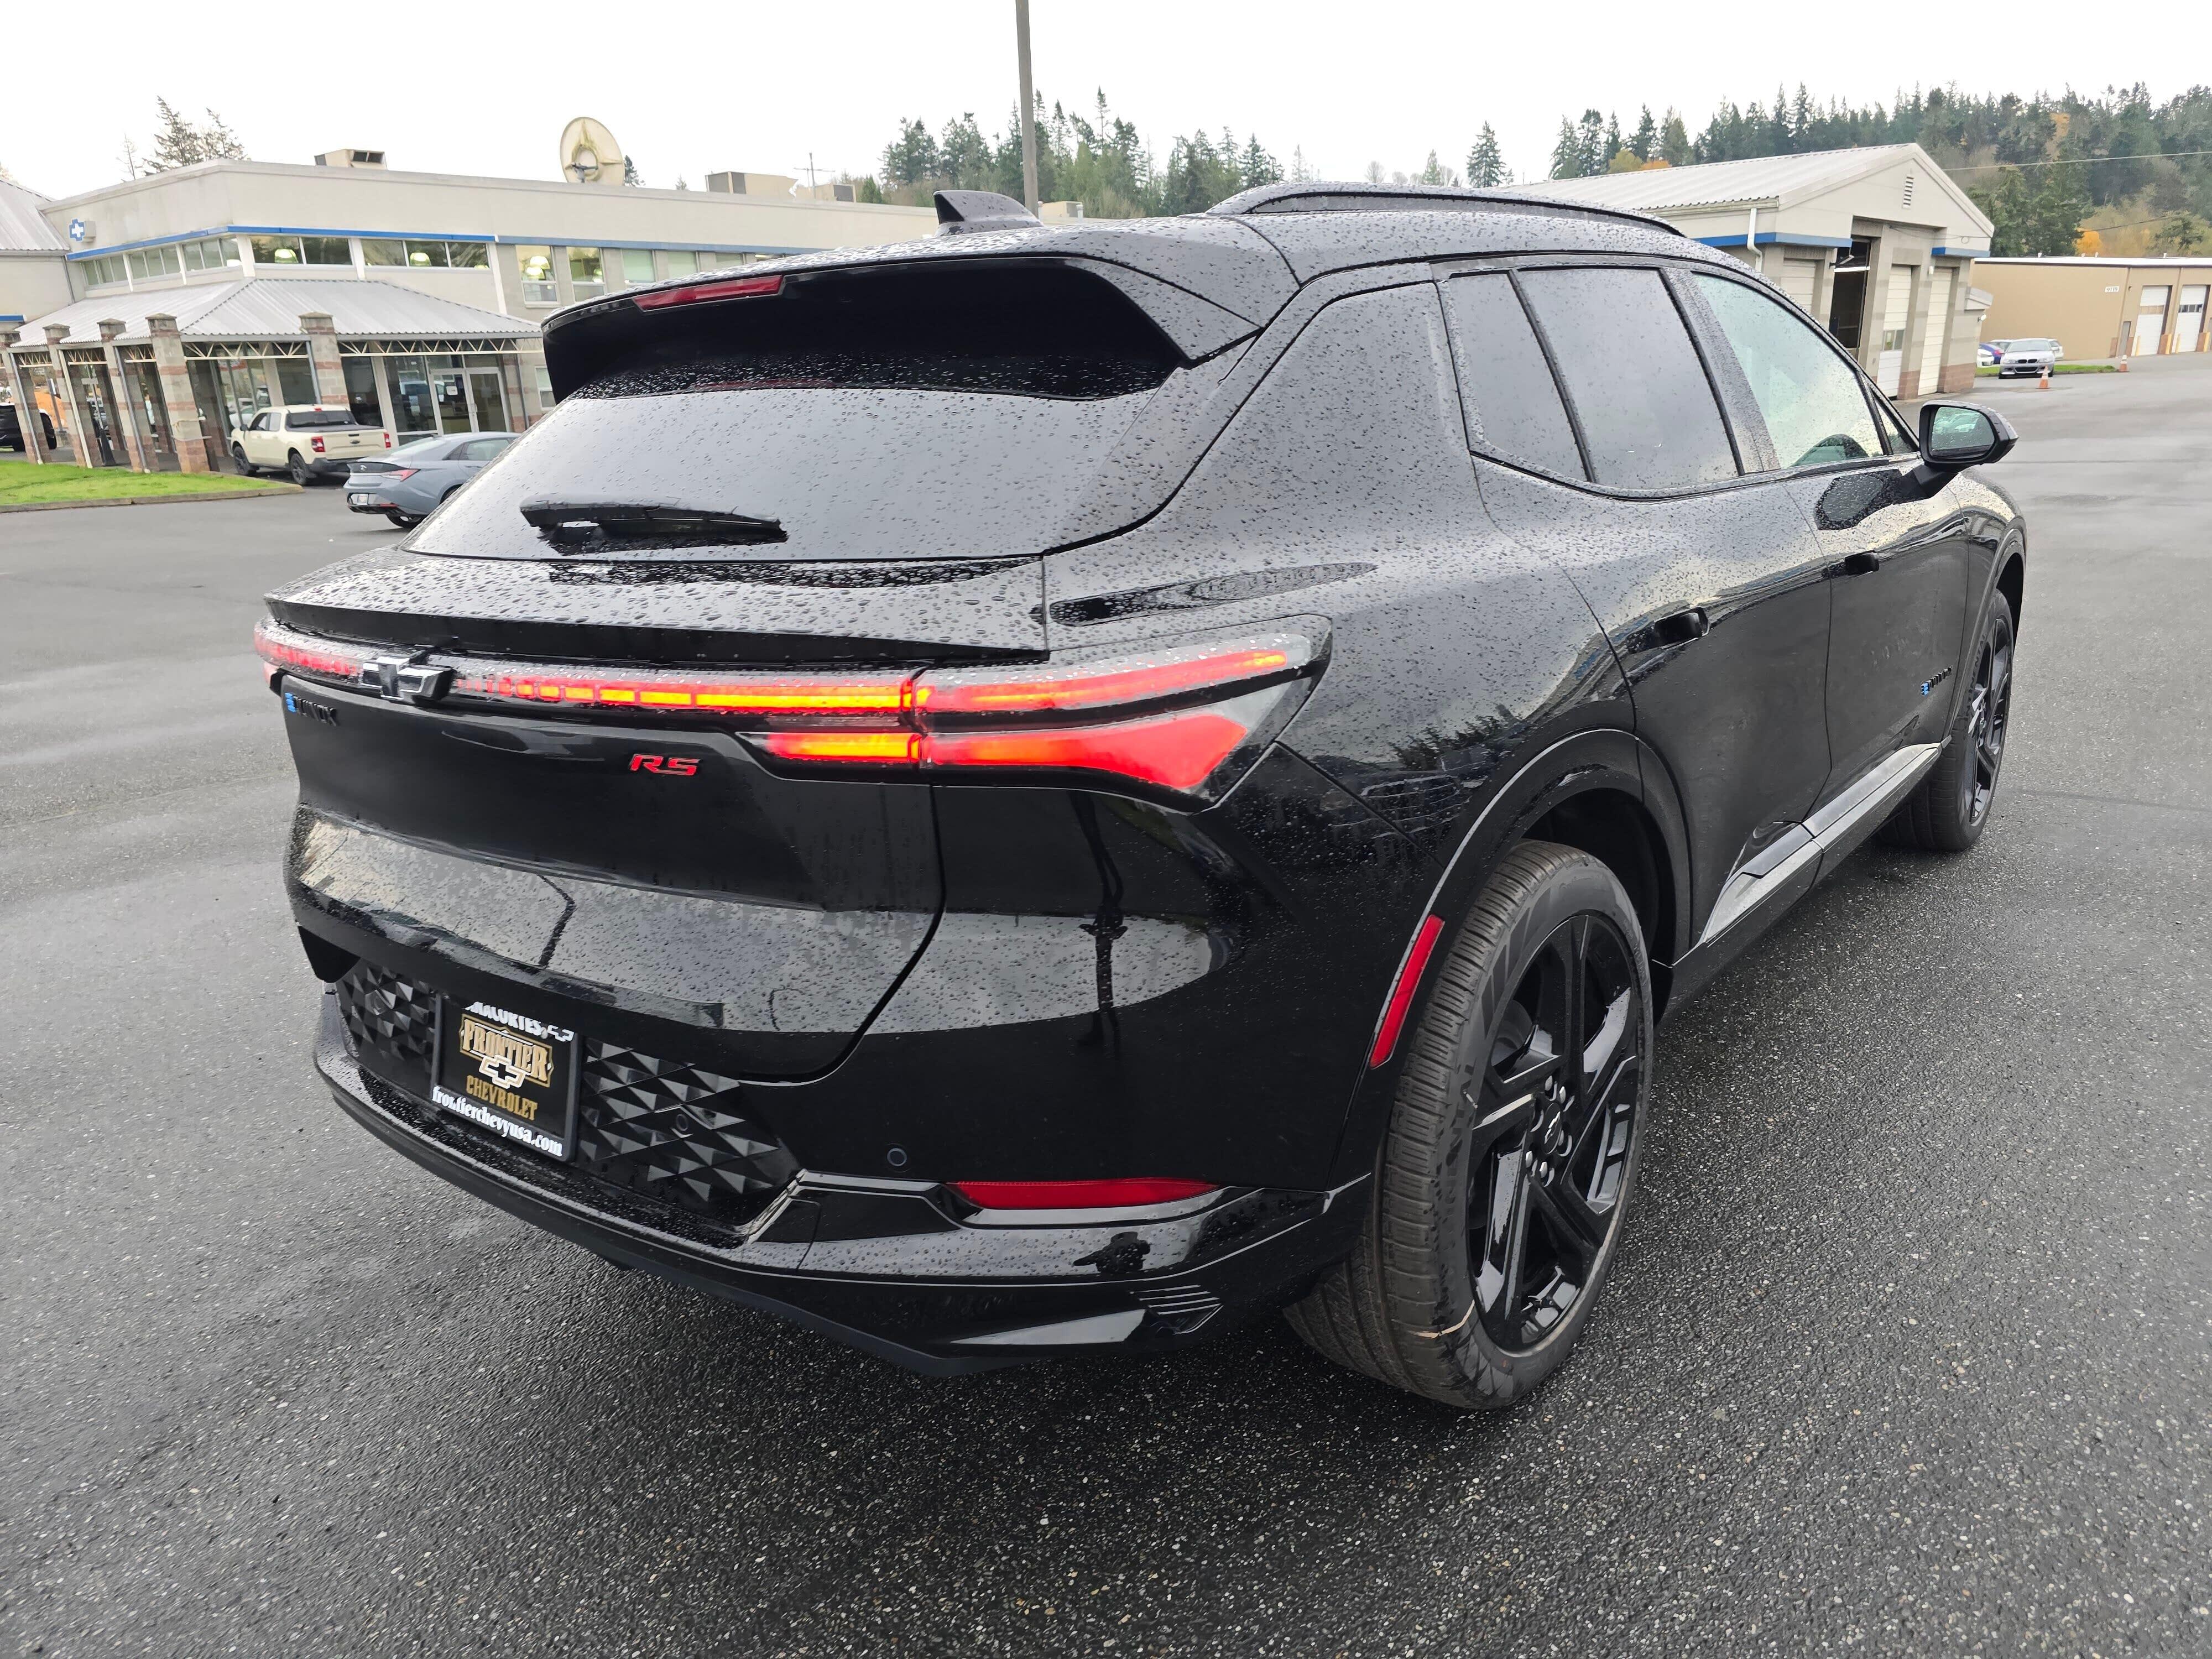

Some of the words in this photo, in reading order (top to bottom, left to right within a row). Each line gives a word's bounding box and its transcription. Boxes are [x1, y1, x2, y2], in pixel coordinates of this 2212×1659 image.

[629, 753, 702, 776] RS
[463, 1019, 548, 1082] FRONTIER
[431, 1084, 563, 1156] frontierchevyusa.com
[466, 1074, 538, 1121] CHEVROLET
